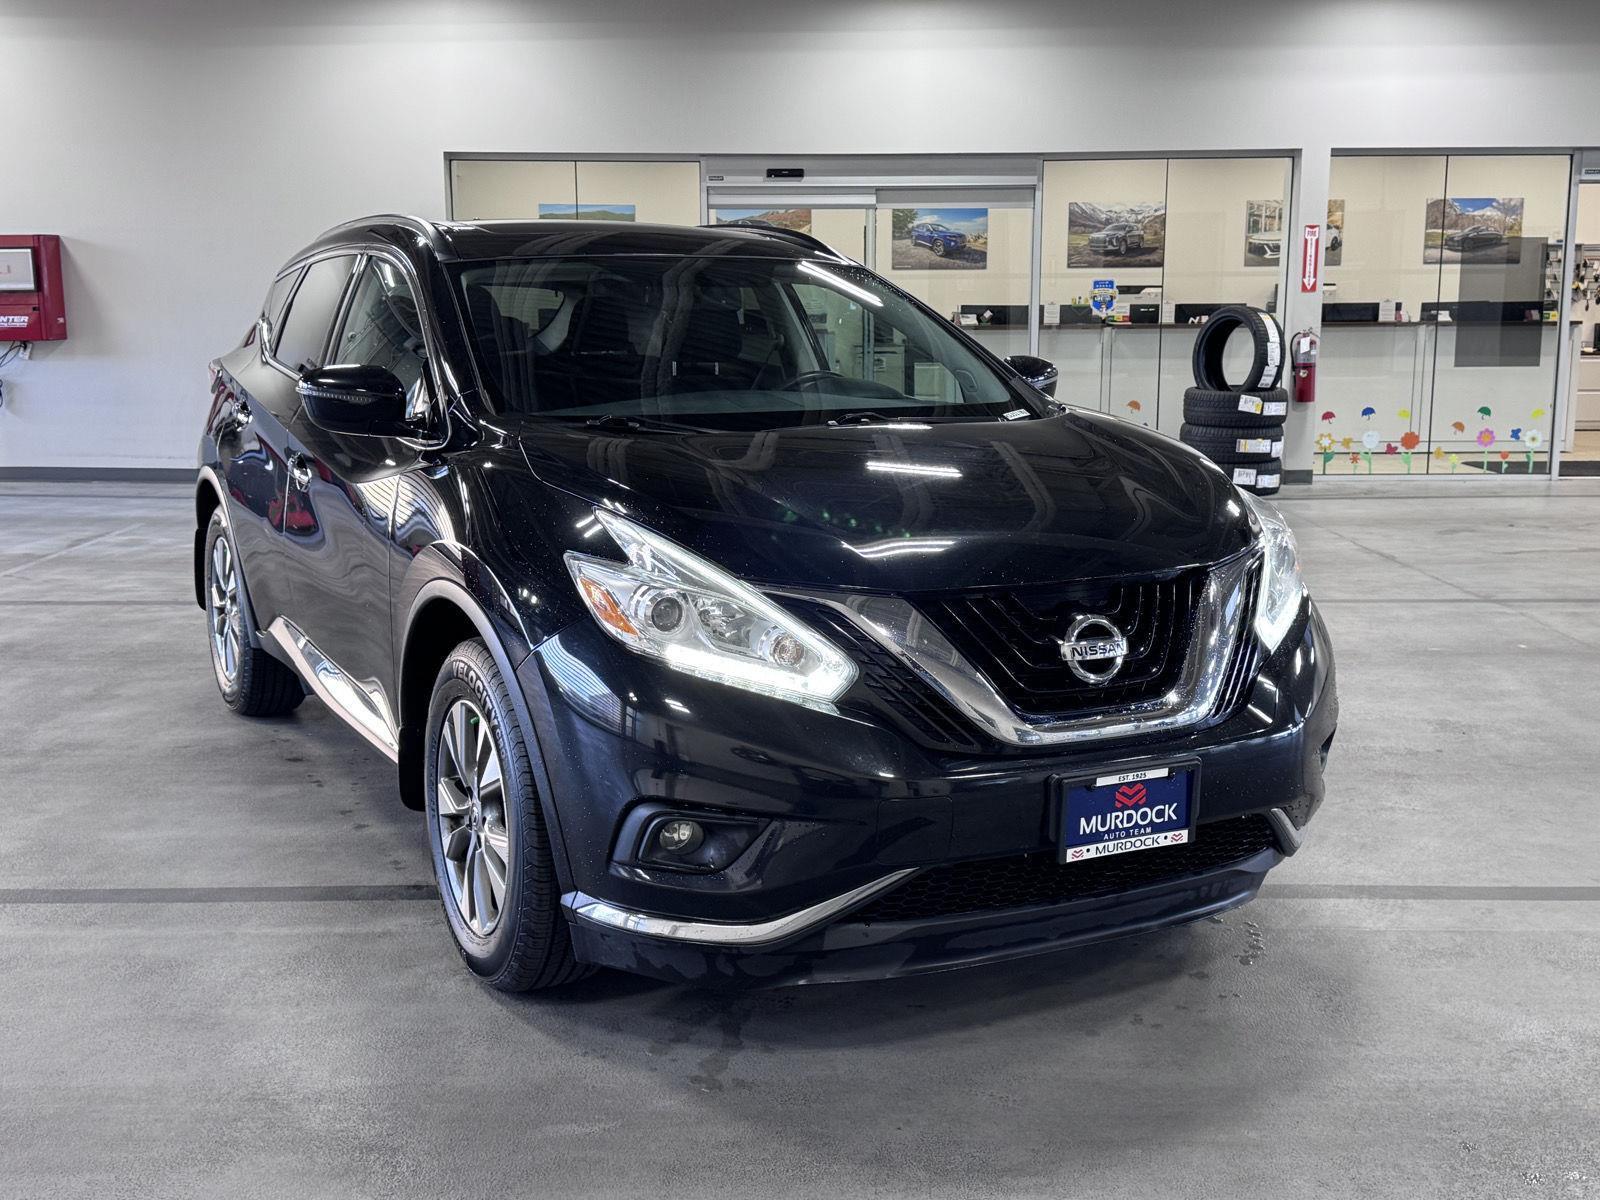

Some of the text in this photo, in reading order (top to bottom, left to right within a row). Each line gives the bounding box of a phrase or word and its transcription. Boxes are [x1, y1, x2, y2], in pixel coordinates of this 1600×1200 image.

[1071, 642, 1124, 657] NISSAN
[1118, 773, 1131, 782] EST.
[1079, 802, 1178, 835] MURDOCK
[1103, 826, 1152, 841] AUTO TEAM
[1095, 835, 1161, 855] MURDOCK
